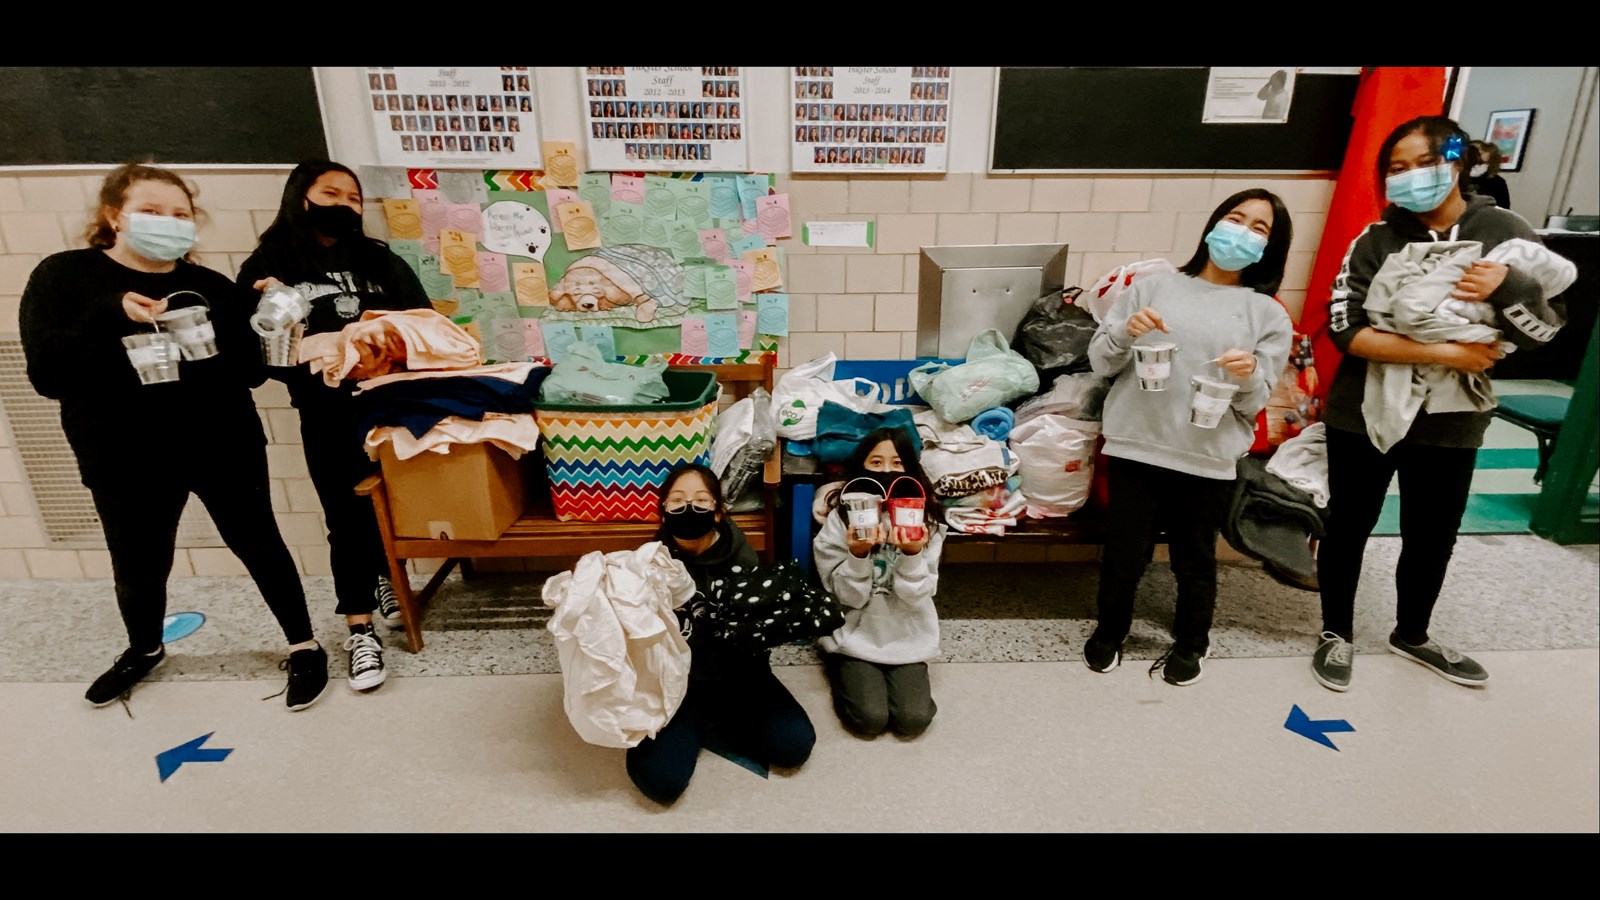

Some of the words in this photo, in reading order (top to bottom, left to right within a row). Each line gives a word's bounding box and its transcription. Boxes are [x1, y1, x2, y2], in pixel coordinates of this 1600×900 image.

[651, 75, 674, 87] Staff
[862, 76, 881, 87] Staff
[643, 88, 662, 96] 2012
[667, 88, 685, 96] 2013
[874, 87, 891, 95] 2014
[1147, 367, 1154, 377] 5
[781, 409, 798, 419] eco
[858, 514, 865, 523] 6
[908, 511, 916, 525] 9
